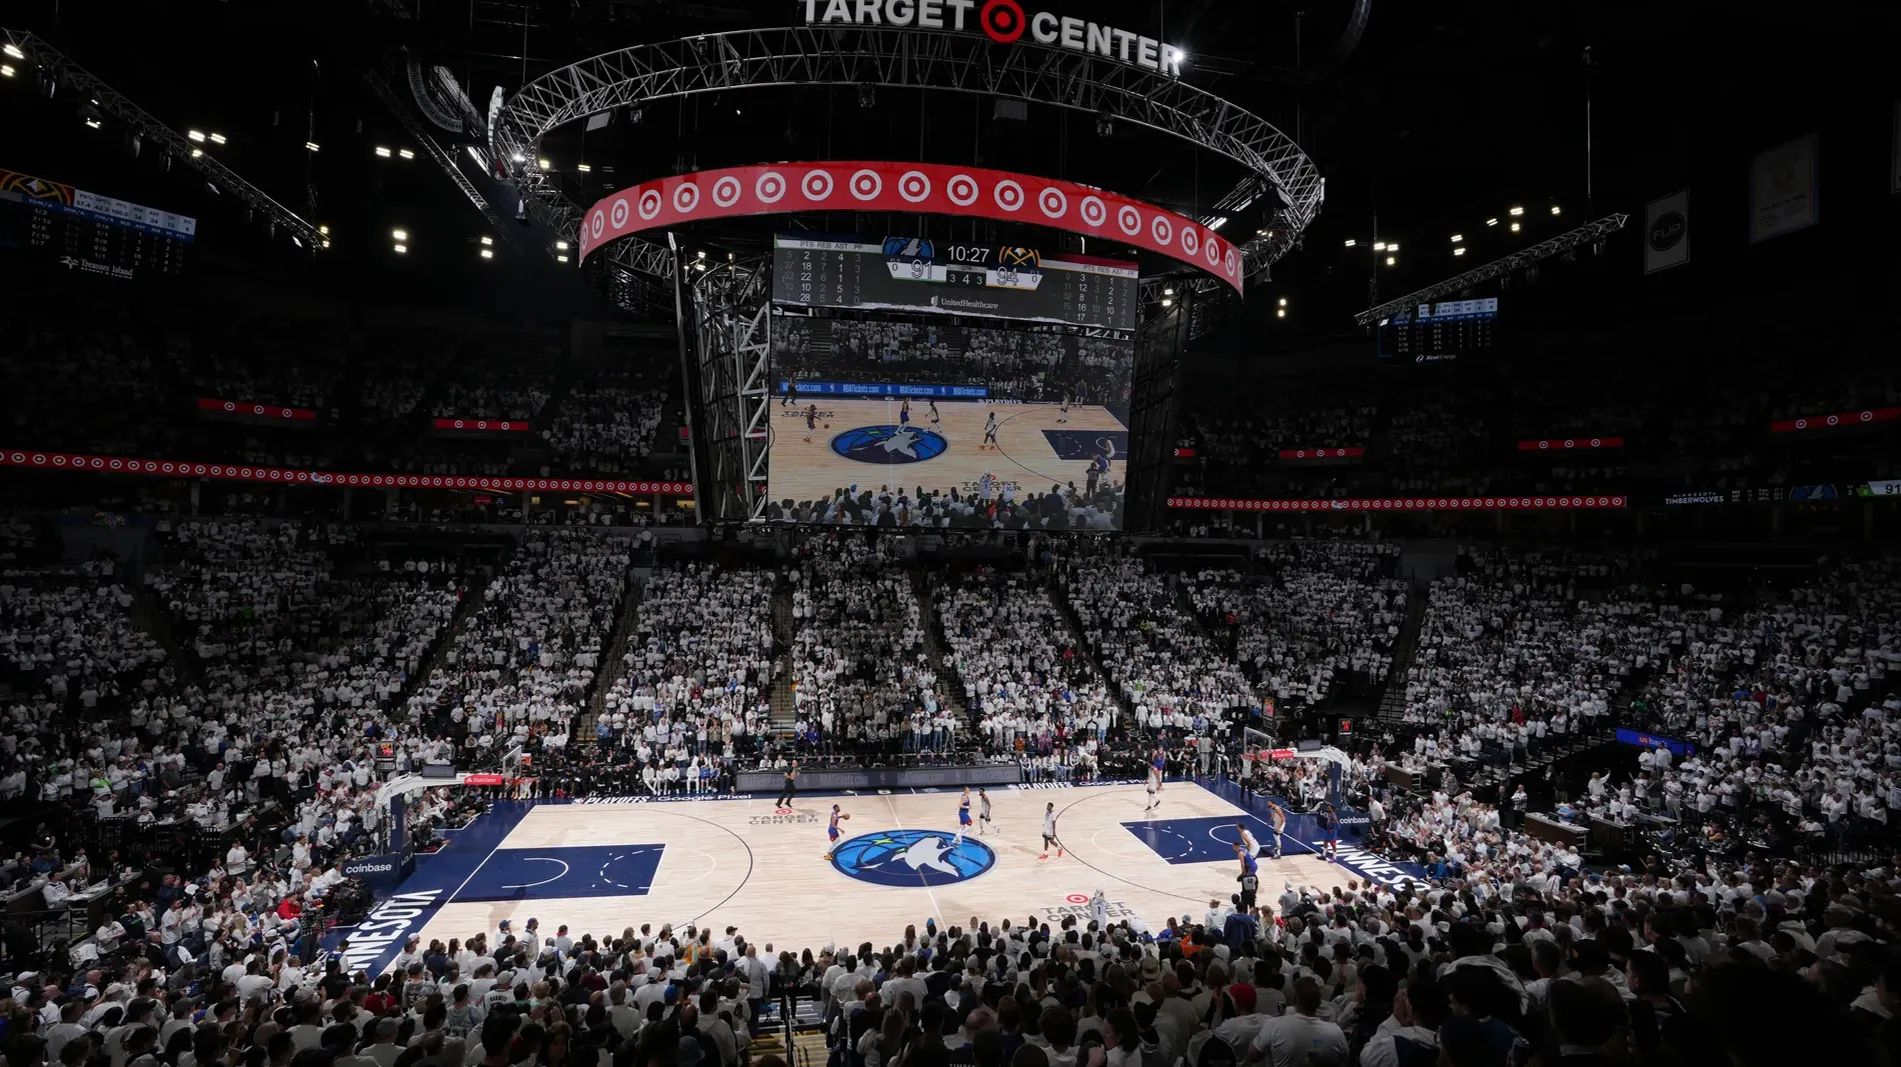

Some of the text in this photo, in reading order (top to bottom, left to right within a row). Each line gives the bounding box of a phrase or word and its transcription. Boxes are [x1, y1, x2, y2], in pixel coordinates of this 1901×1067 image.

[804, 0, 1182, 75] TARGET CENTER
[111, 208, 129, 217] 100.0
[1652, 223, 1681, 241] FLIP
[834, 243, 848, 251] AST
[804, 251, 810, 259] 2
[820, 252, 828, 261] 2
[838, 253, 844, 261] 4
[855, 254, 861, 263] 3
[947, 245, 990, 264] 10:27
[81, 258, 111, 272] Treasure
[112, 265, 134, 276] Island
[801, 262, 812, 271] 18
[820, 263, 827, 271] 7
[854, 265, 861, 273] 3
[891, 264, 898, 272] 0
[911, 258, 933, 280] 91
[1083, 264, 1095, 272] PTS
[1112, 268, 1124, 276] AST
[800, 272, 812, 281] 22
[820, 273, 827, 282] 6
[949, 274, 983, 284] 3 4 3
[996, 266, 1019, 287] 94
[1032, 275, 1038, 283] 0
[1080, 273, 1086, 282] 3
[800, 283, 812, 291] 10
[819, 284, 826, 292] 2
[837, 285, 843, 293] 5
[854, 285, 860, 294] 3
[1078, 283, 1088, 292] 12
[1108, 286, 1114, 295] 2
[800, 293, 811, 302] 28
[836, 295, 843, 303] 4
[941, 297, 999, 310] UnitedHealthcare
[1078, 293, 1084, 302] 8
[1108, 296, 1113, 305] 2
[1077, 302, 1086, 312] 16
[1106, 306, 1115, 315] 10
[1120, 307, 1126, 316] 4
[1077, 313, 1086, 322] 17
[1885, 484, 1901, 494] 91
[1664, 495, 1725, 505] TIMBERWOLVES
[1018, 780, 1074, 791] PLAYOFFS
[584, 796, 651, 805] PLAYOFFS
[657, 794, 714, 803] Google
[748, 818, 819, 826] CENTER
[750, 814, 817, 822] TARGET
[1339, 816, 1370, 825] coinbase
[345, 863, 392, 875] coinbase
[1311, 840, 1431, 893] MINNESO
